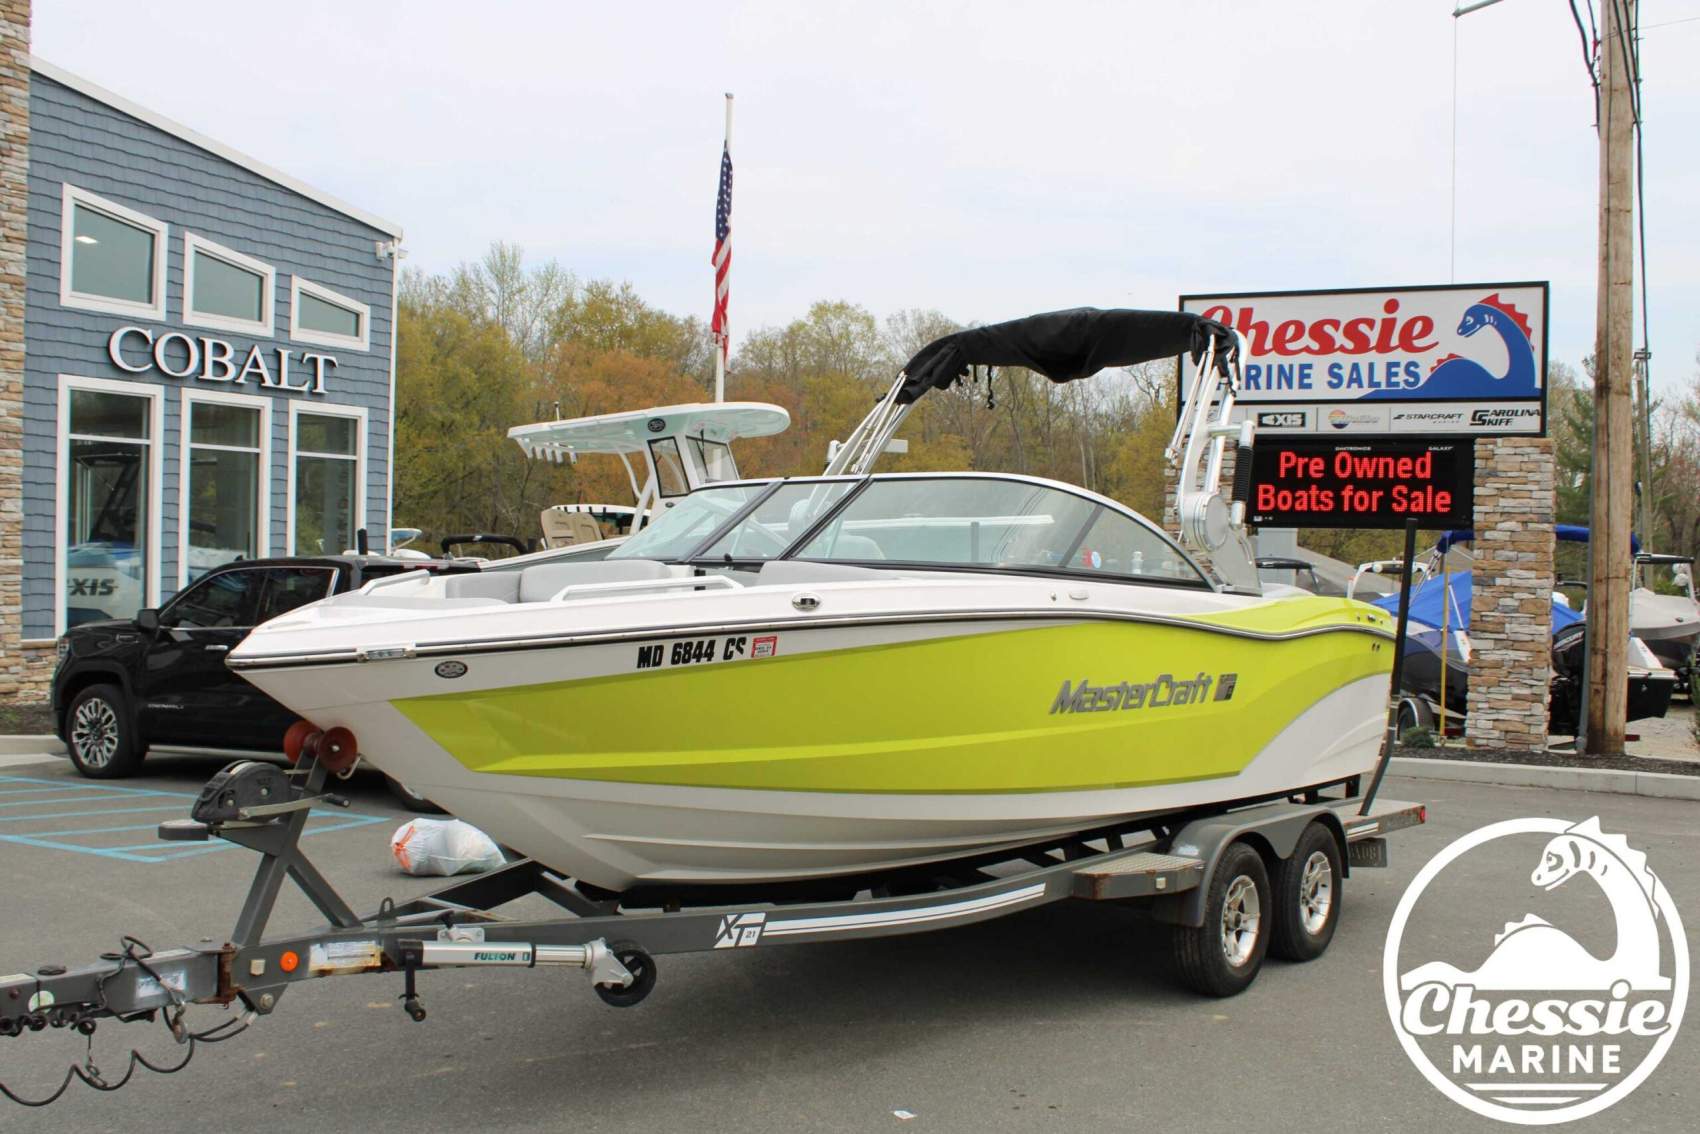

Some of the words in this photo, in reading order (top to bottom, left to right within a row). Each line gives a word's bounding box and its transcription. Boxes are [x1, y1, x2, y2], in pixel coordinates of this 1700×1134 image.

[108, 326, 338, 394] COBALT
[1215, 361, 1313, 391] RINE
[1327, 360, 1421, 389] SALES
[1280, 451, 1325, 478] Pre
[1334, 451, 1432, 479] Owned
[1257, 484, 1334, 511] Boats
[1341, 485, 1383, 512] for
[1391, 485, 1451, 512] Sale
[66, 578, 116, 596] XIS
[637, 645, 664, 668] MD
[671, 640, 716, 665] 6844
[1049, 672, 1213, 714] MasterCraft
[474, 952, 515, 961] FULTON
